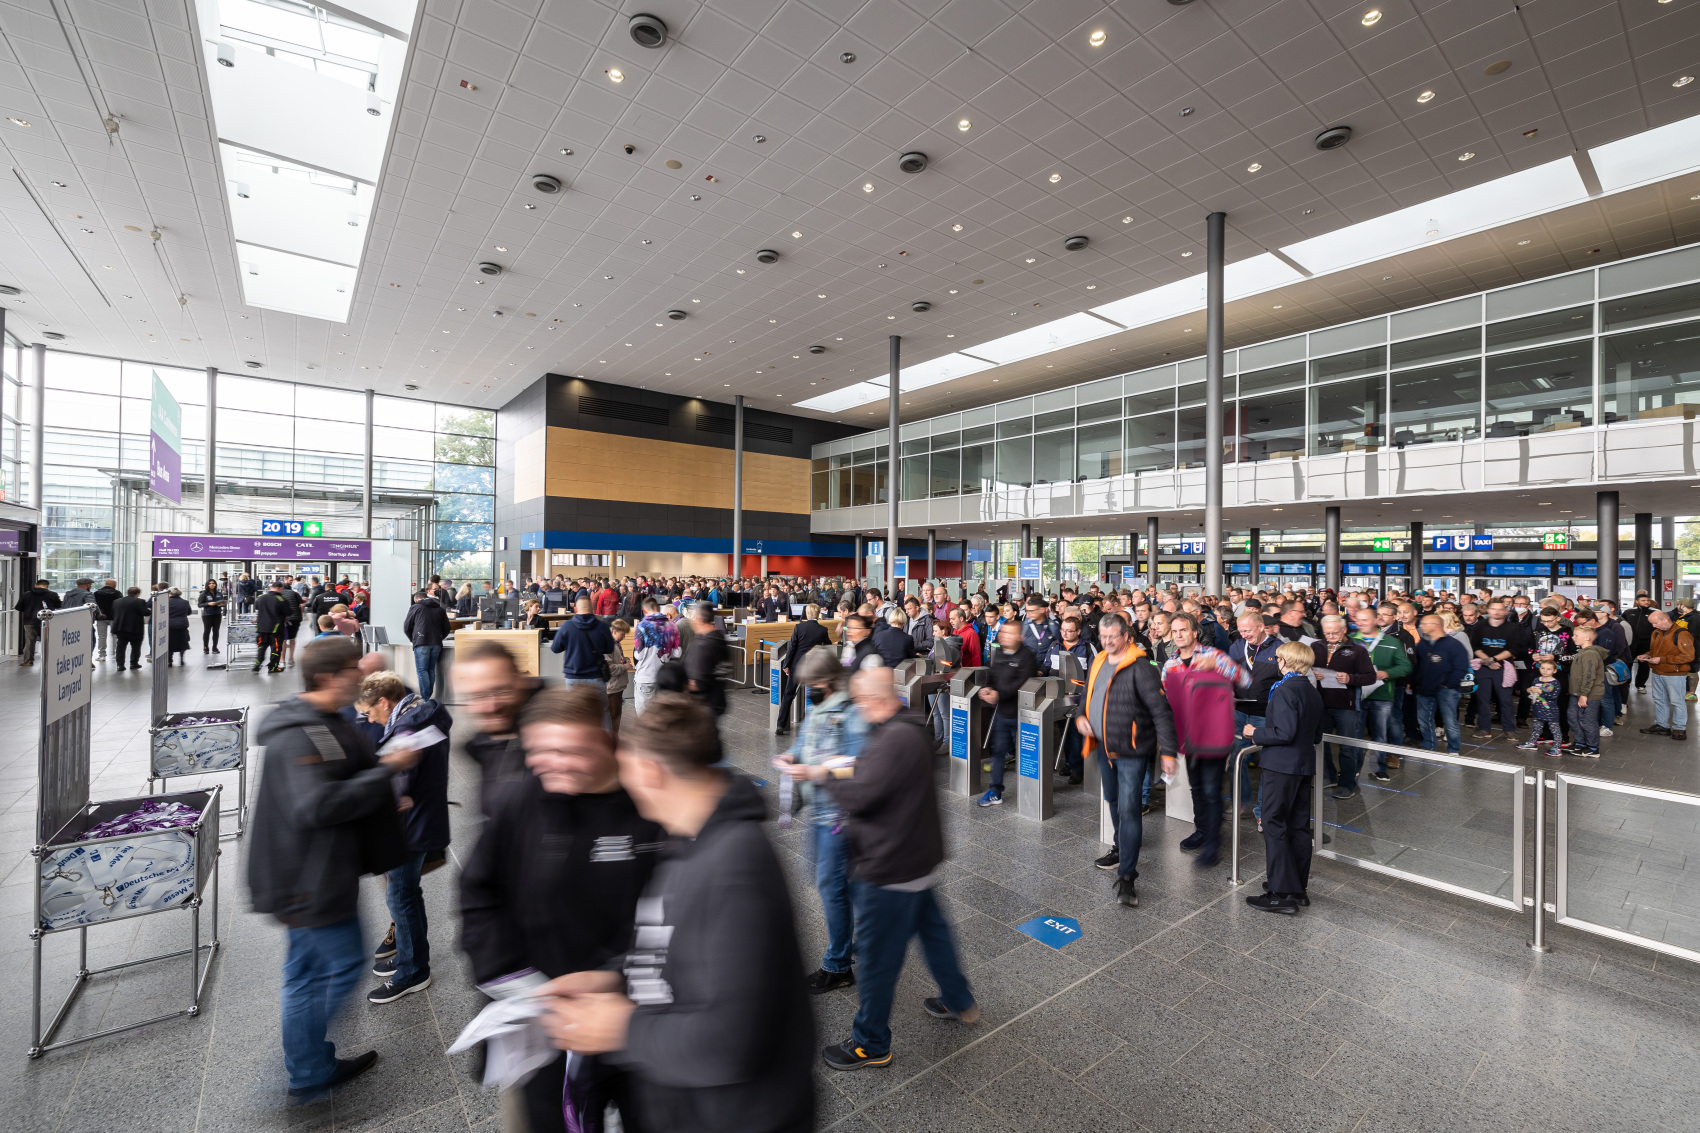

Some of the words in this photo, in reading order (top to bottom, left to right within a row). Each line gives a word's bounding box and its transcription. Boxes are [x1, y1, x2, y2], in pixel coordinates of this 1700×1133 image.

[263, 521, 281, 533] 20
[284, 522, 301, 534] 19
[1182, 543, 1190, 552] P
[1436, 537, 1447, 549] P
[62, 628, 80, 647] Please
[56, 655, 70, 676] take
[70, 653, 85, 675] your
[58, 674, 82, 701] Lanyard
[123, 872, 164, 890] Deutsche
[163, 886, 188, 903] Messe
[1043, 919, 1077, 934] EXIT
